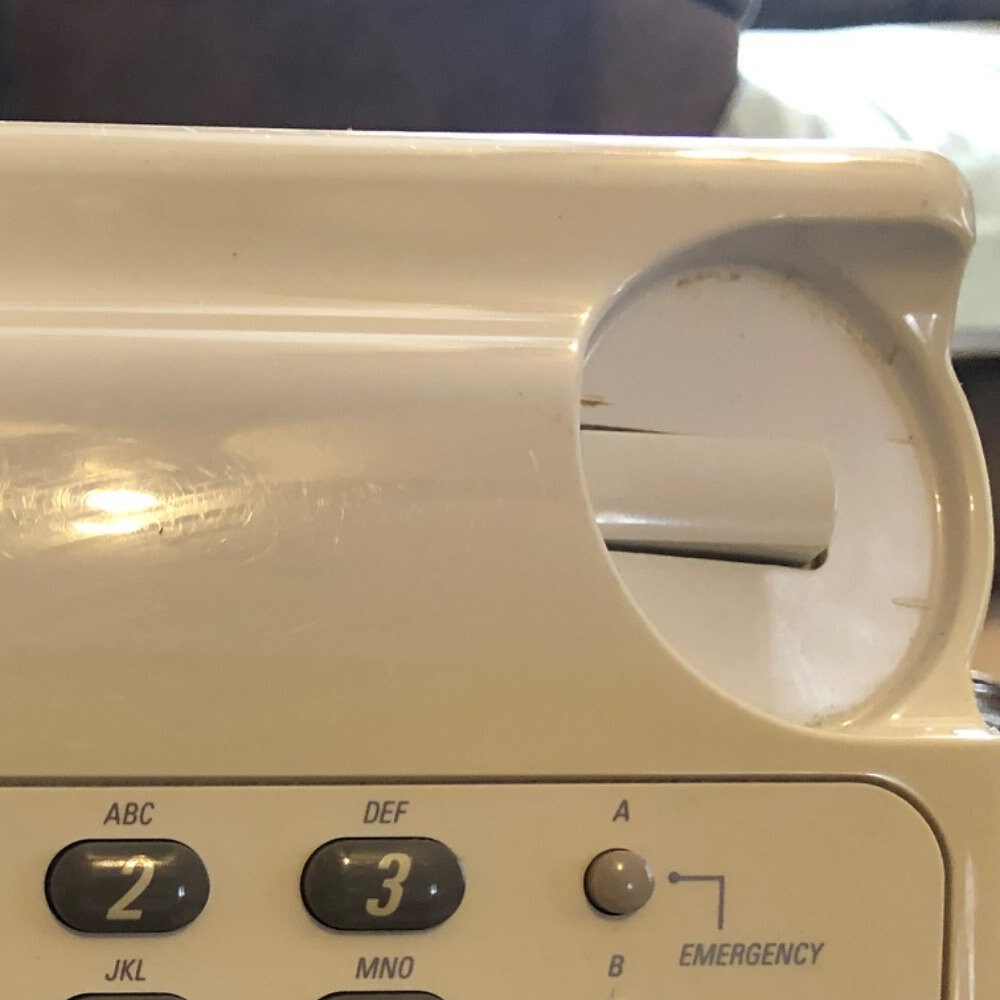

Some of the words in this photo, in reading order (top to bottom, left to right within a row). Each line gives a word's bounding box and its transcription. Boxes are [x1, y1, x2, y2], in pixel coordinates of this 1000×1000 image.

[103, 802, 155, 825] ABC
[364, 801, 409, 823] DEF
[612, 800, 630, 822] A
[107, 854, 156, 920] 2
[365, 852, 412, 916] 3
[608, 955, 625, 977] B
[679, 943, 824, 966] EMERGENCY
[105, 959, 145, 981] JKL
[356, 956, 414, 979] MNO
